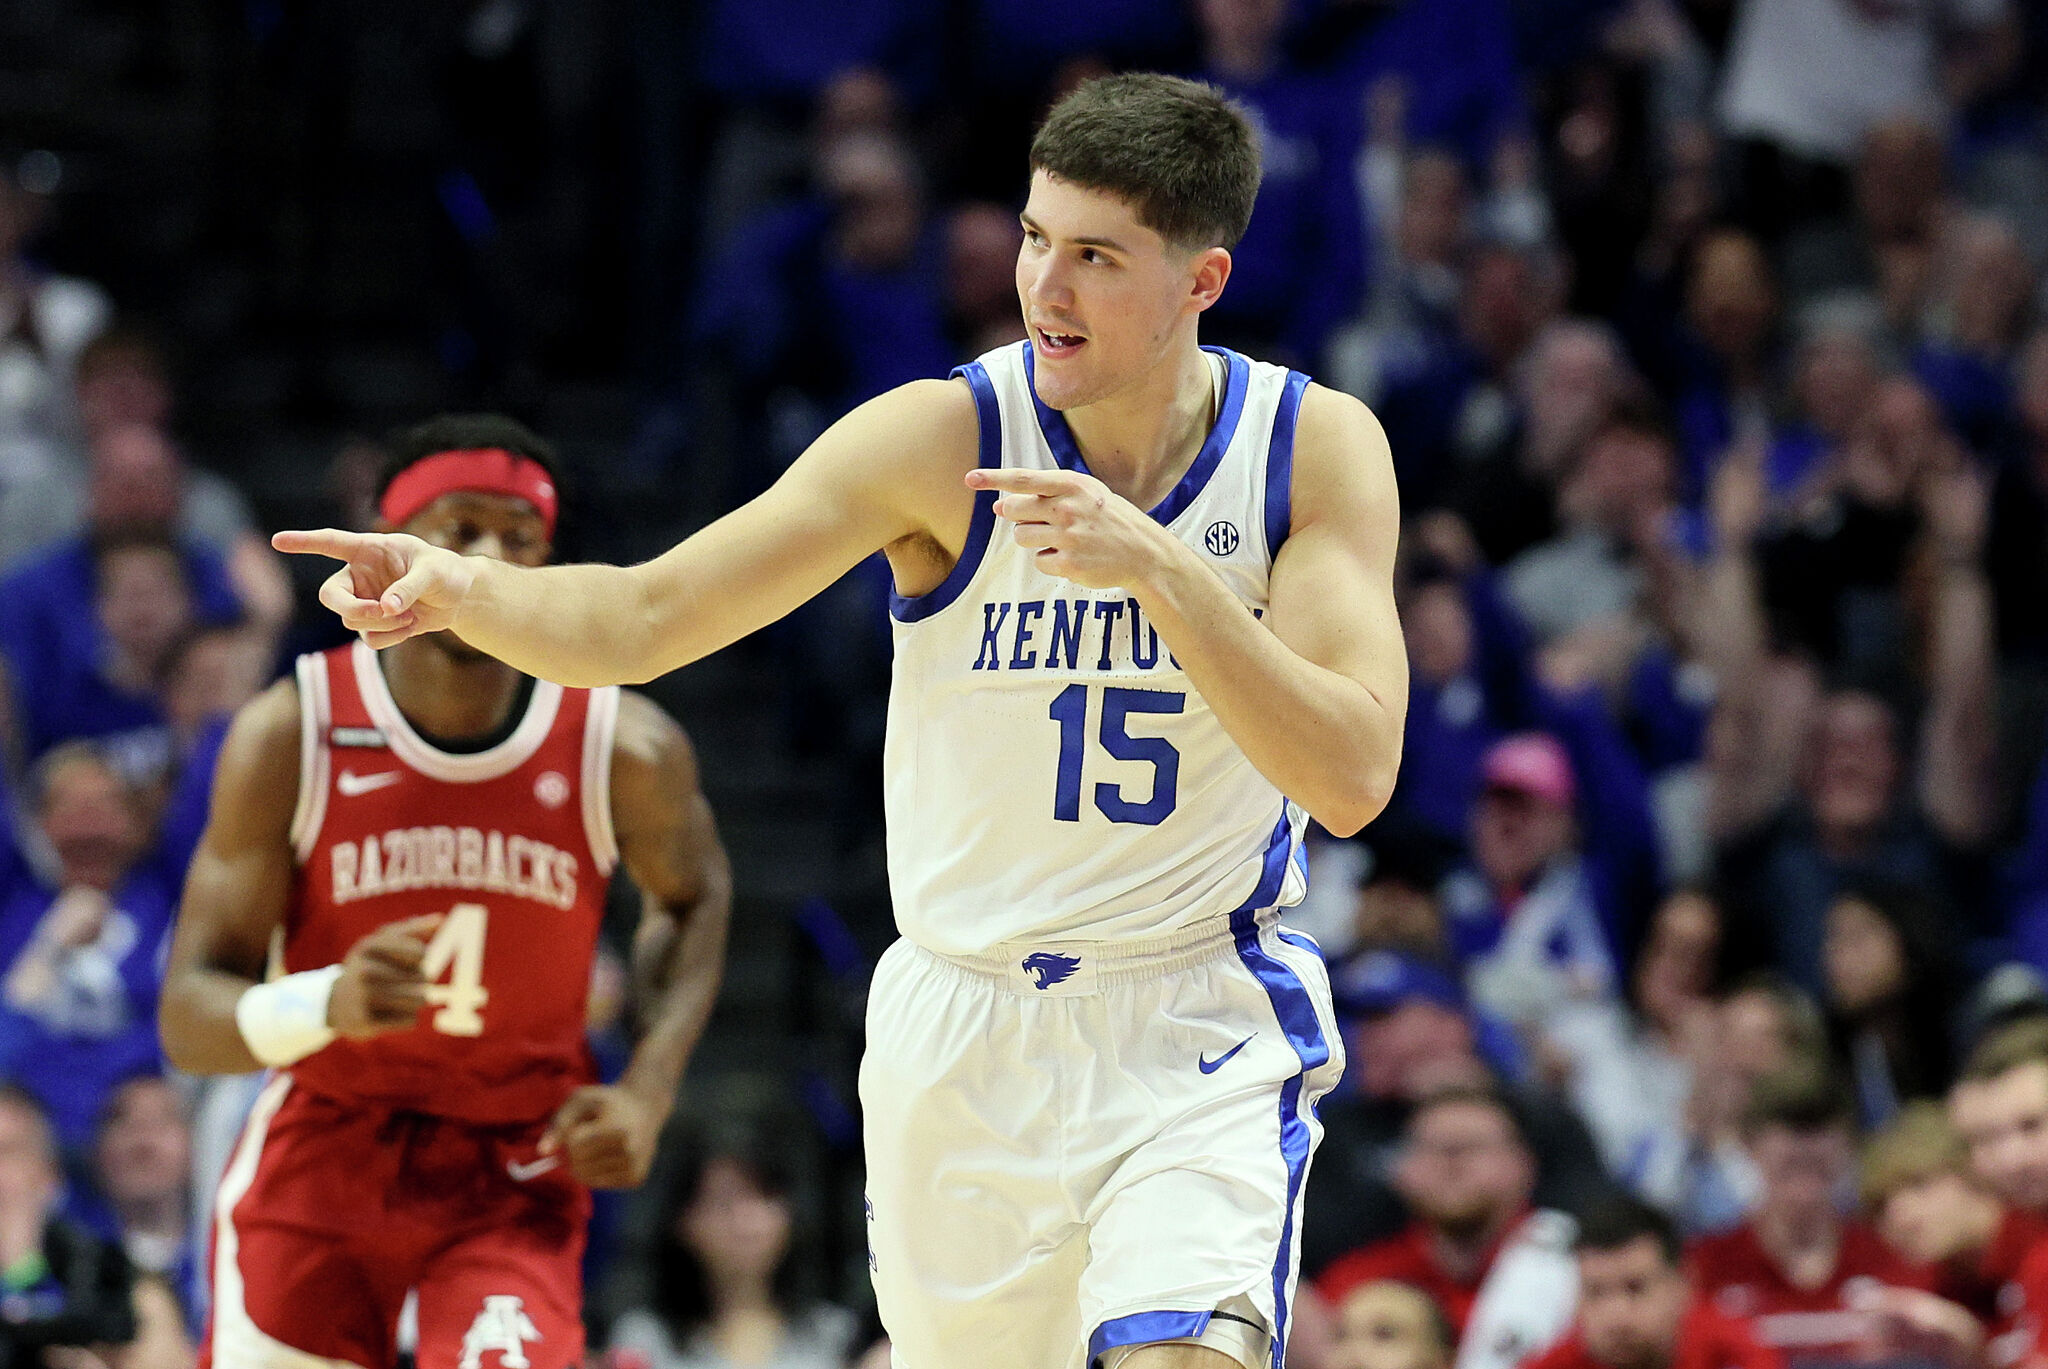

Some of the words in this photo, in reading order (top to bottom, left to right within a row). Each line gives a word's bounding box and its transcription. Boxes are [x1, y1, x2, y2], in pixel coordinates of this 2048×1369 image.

[1206, 522, 1238, 555] SEC
[972, 597, 1263, 671] KENTU
[1049, 683, 1186, 825] 15
[331, 826, 578, 911] RAZORBACKS
[423, 902, 489, 1037] 4
